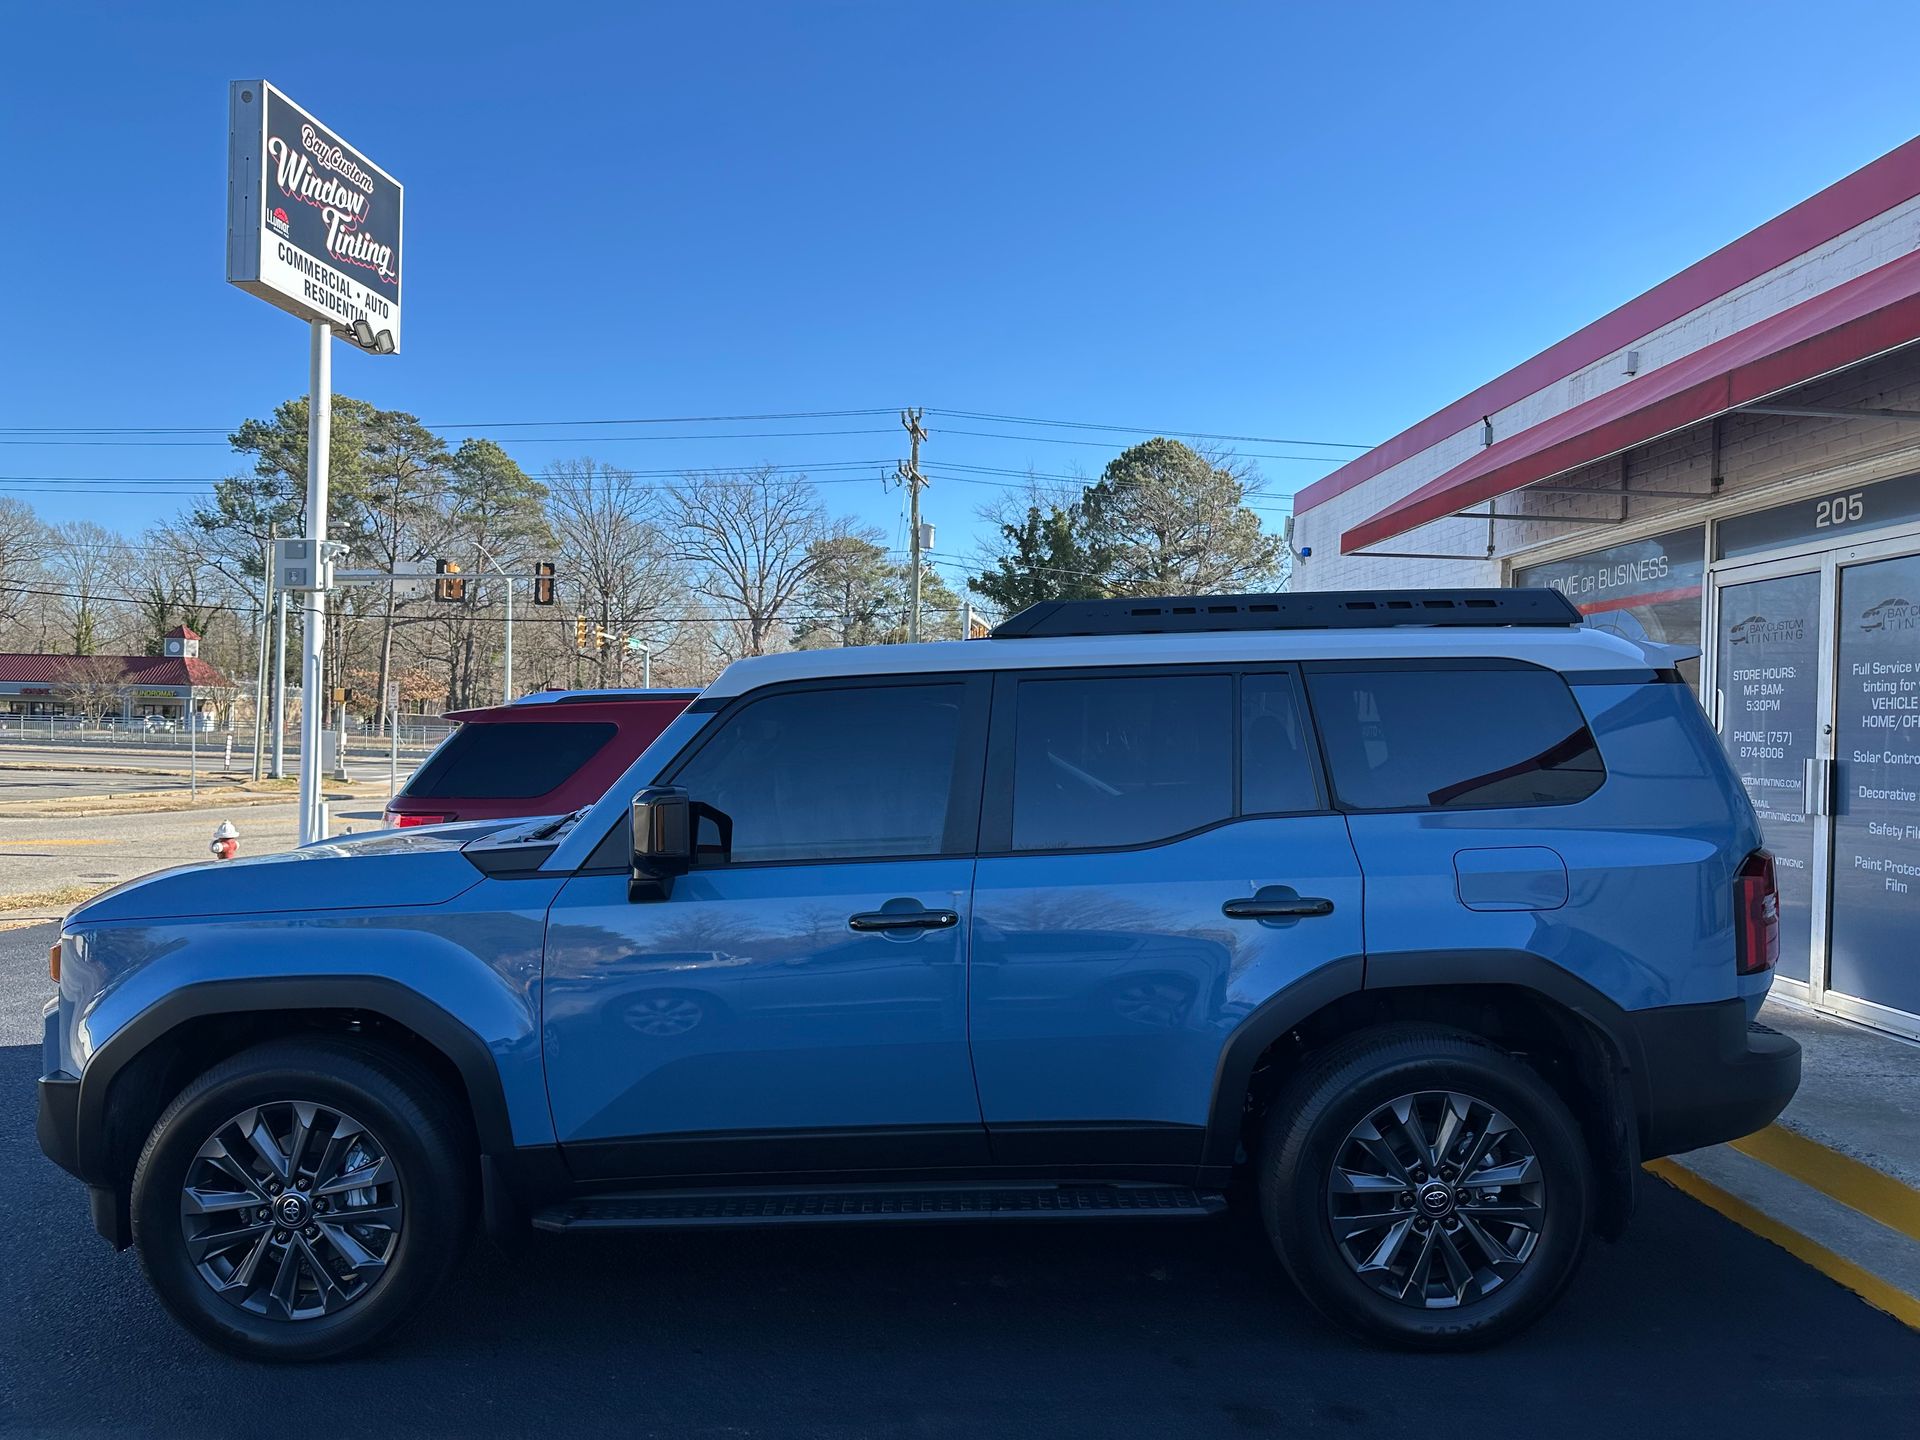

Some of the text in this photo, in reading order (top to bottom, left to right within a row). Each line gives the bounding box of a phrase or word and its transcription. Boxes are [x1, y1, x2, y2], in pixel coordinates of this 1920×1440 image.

[302, 125, 374, 194] Bay Custom
[268, 137, 366, 216] Window
[322, 207, 396, 277] Tinting
[278, 242, 390, 320] COMMERCIAL AUTO
[1816, 492, 1863, 528] 205
[1598, 556, 1669, 589] BUSINESS
[1888, 604, 1920, 619] BAY C
[1749, 619, 1804, 633] BAY CUSTOM
[1888, 617, 1920, 631] TIN
[1750, 629, 1804, 644] TINTING
[1733, 666, 1797, 681] STORE HOURS:
[1852, 663, 1870, 676] Full
[1872, 660, 1912, 675] Service
[1743, 683, 1785, 696] M-F 9AM-
[1863, 679, 1916, 695] tinting for
[1746, 699, 1780, 711] 5:30PM
[1871, 697, 1919, 710] VEHICLE
[1733, 731, 1793, 746] PHONE: (757)
[1740, 746, 1785, 759] 874-8006
[1853, 750, 1881, 763] Solar
[1859, 785, 1916, 802] Decorative
[1869, 822, 1920, 840] Safety Fil
[1854, 855, 1882, 871] Paint
[1885, 877, 1908, 893] Film
